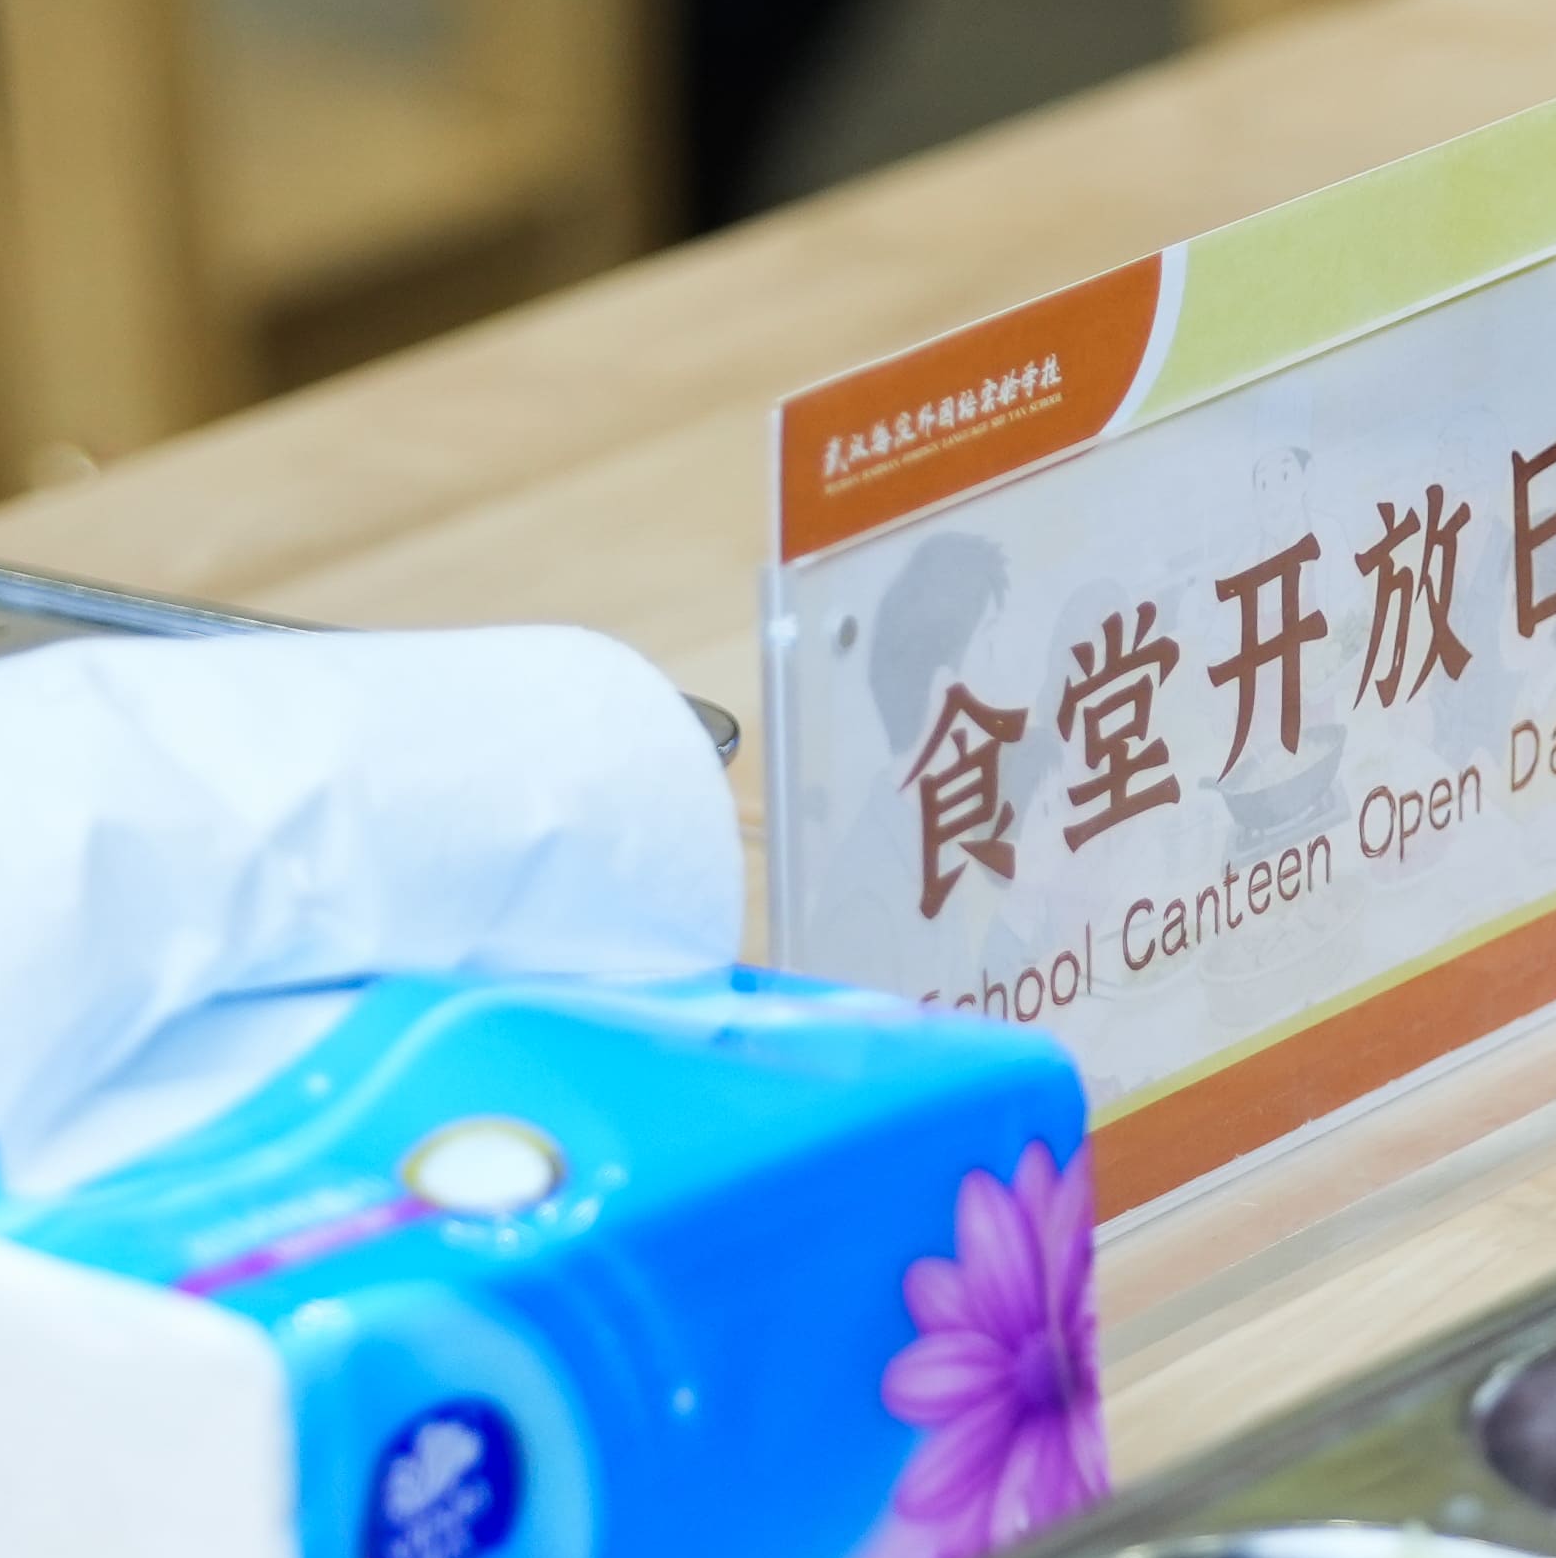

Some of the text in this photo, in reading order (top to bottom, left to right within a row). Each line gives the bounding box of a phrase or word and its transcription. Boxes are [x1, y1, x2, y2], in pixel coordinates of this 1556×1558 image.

[920, 918, 1092, 1023] hool
[1122, 831, 1333, 971] Canteen
[1358, 763, 1484, 863] Open
